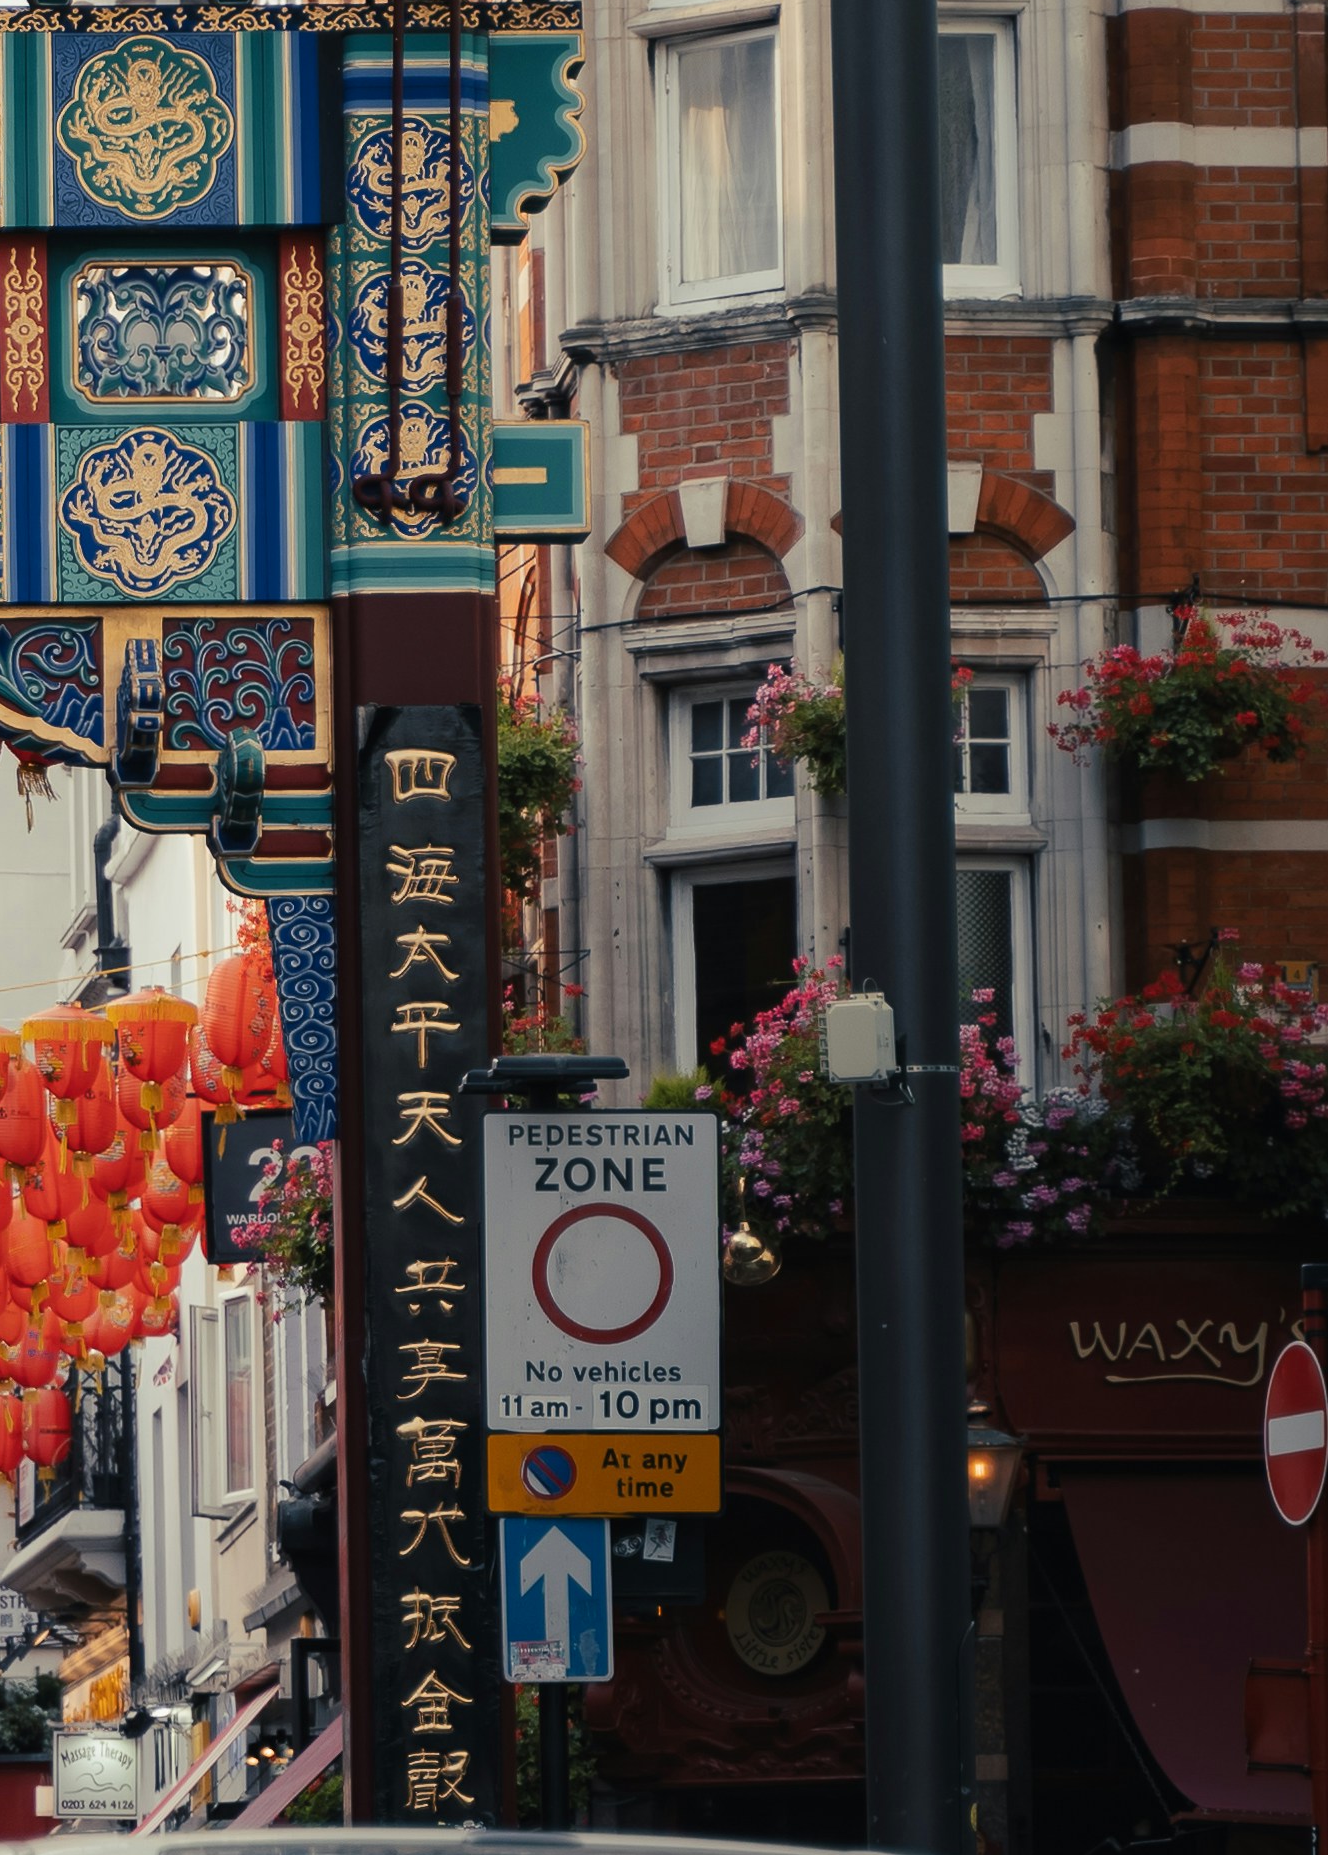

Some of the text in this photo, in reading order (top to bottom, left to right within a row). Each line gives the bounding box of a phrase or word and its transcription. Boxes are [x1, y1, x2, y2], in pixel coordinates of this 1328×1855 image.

[509, 1124, 695, 1146] PEDESTRIAN
[534, 1157, 667, 1191] ZONE
[526, 1360, 682, 1383] No vehicles
[501, 1395, 522, 1417] 11
[530, 1399, 569, 1418] am
[599, 1391, 639, 1418] 10
[649, 1395, 702, 1424] pm
[643, 1451, 687, 1474] any
[617, 1477, 674, 1497] time
[60, 1741, 134, 1770] Massage Therapy
[62, 1800, 134, 1809] 0203 624 4126
